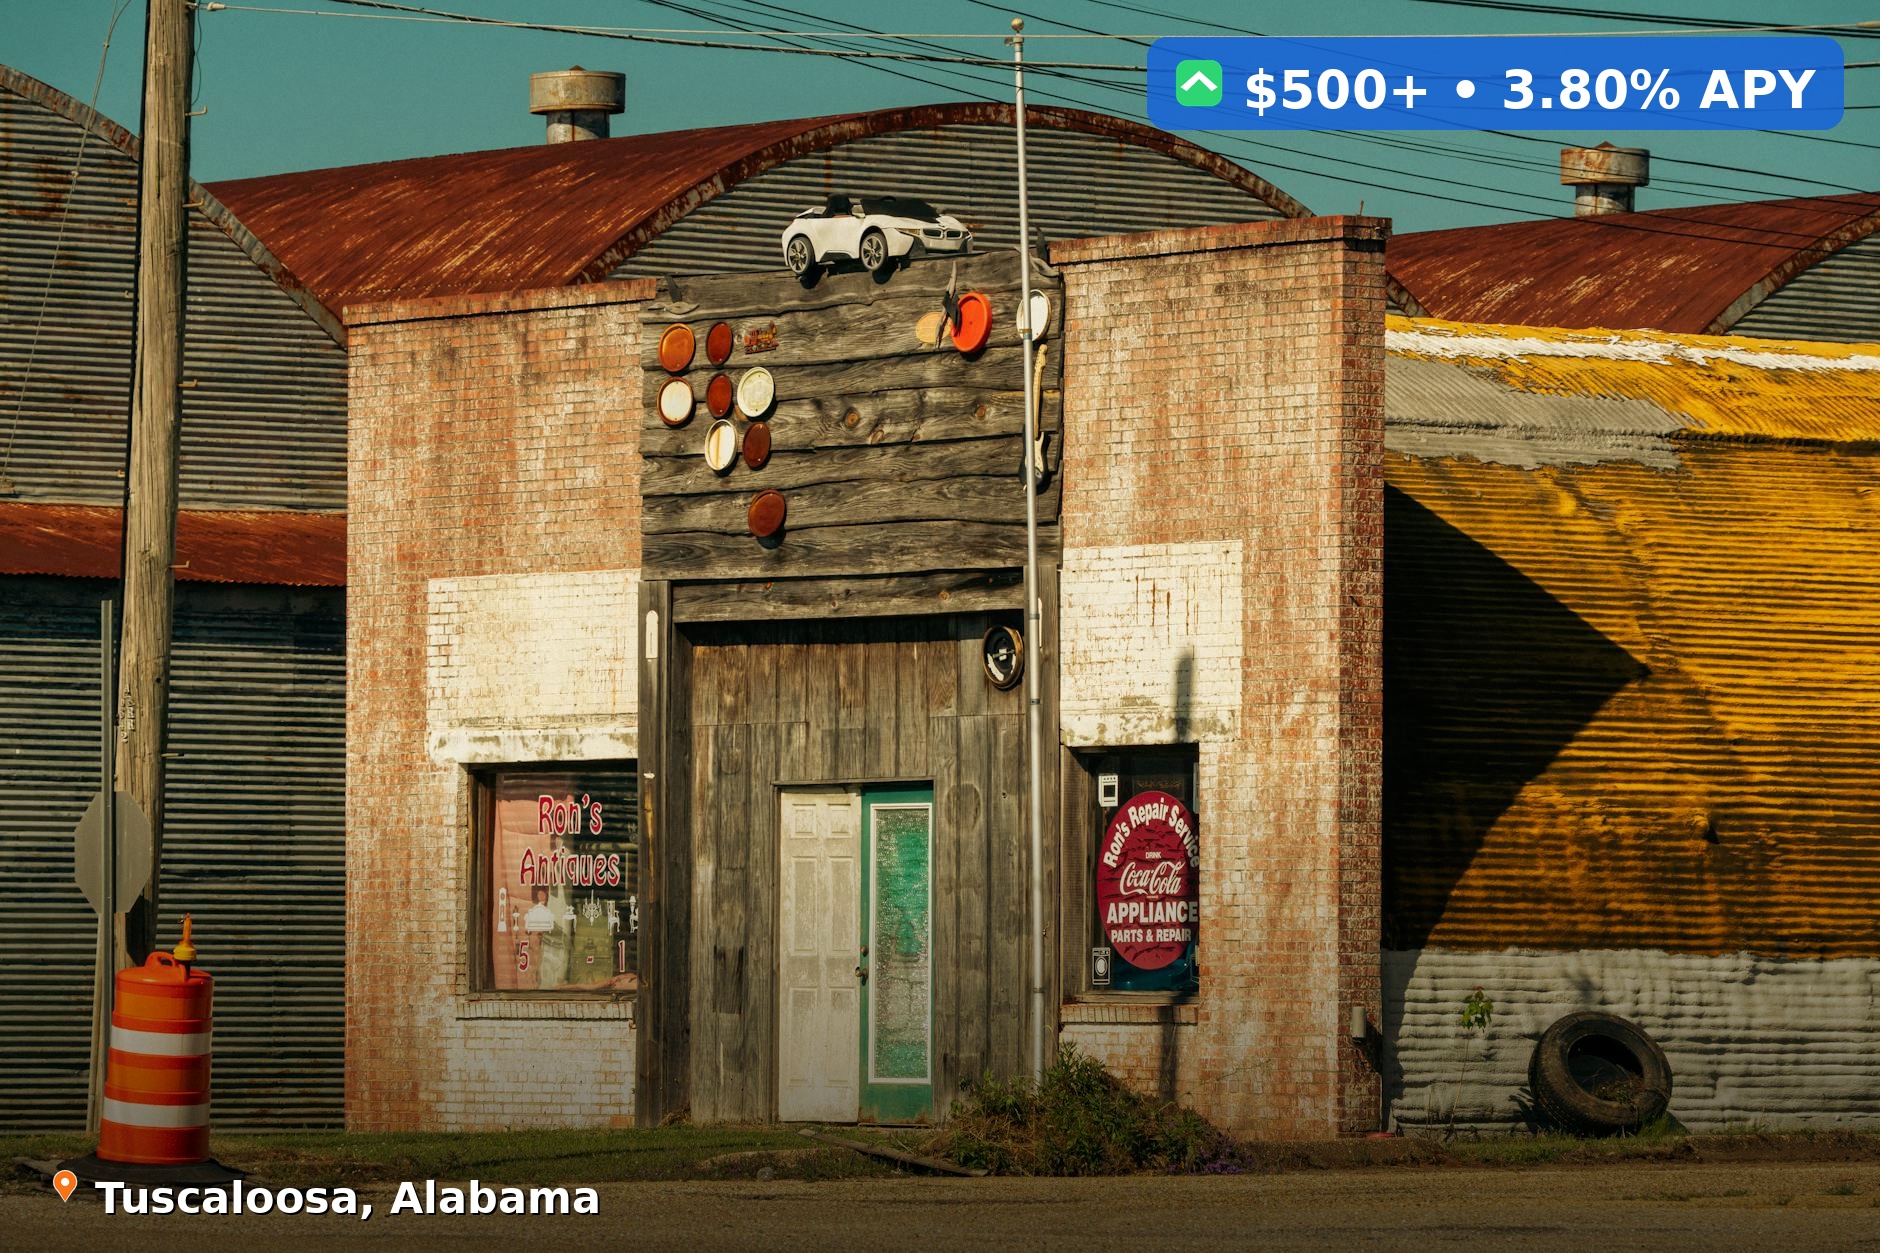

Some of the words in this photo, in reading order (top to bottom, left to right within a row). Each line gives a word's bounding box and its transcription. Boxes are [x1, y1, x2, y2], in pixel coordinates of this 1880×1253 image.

[538, 794, 603, 835] Ron's
[1103, 821, 1131, 868] Ron's
[1127, 797, 1169, 829] Repair
[1168, 805, 1199, 868] Service
[519, 848, 621, 886] Antiques
[1107, 901, 1198, 923] APPLIANCE
[1111, 929, 1143, 943] PARTS
[1145, 929, 1154, 942] &
[1156, 928, 1192, 942] REPAIR
